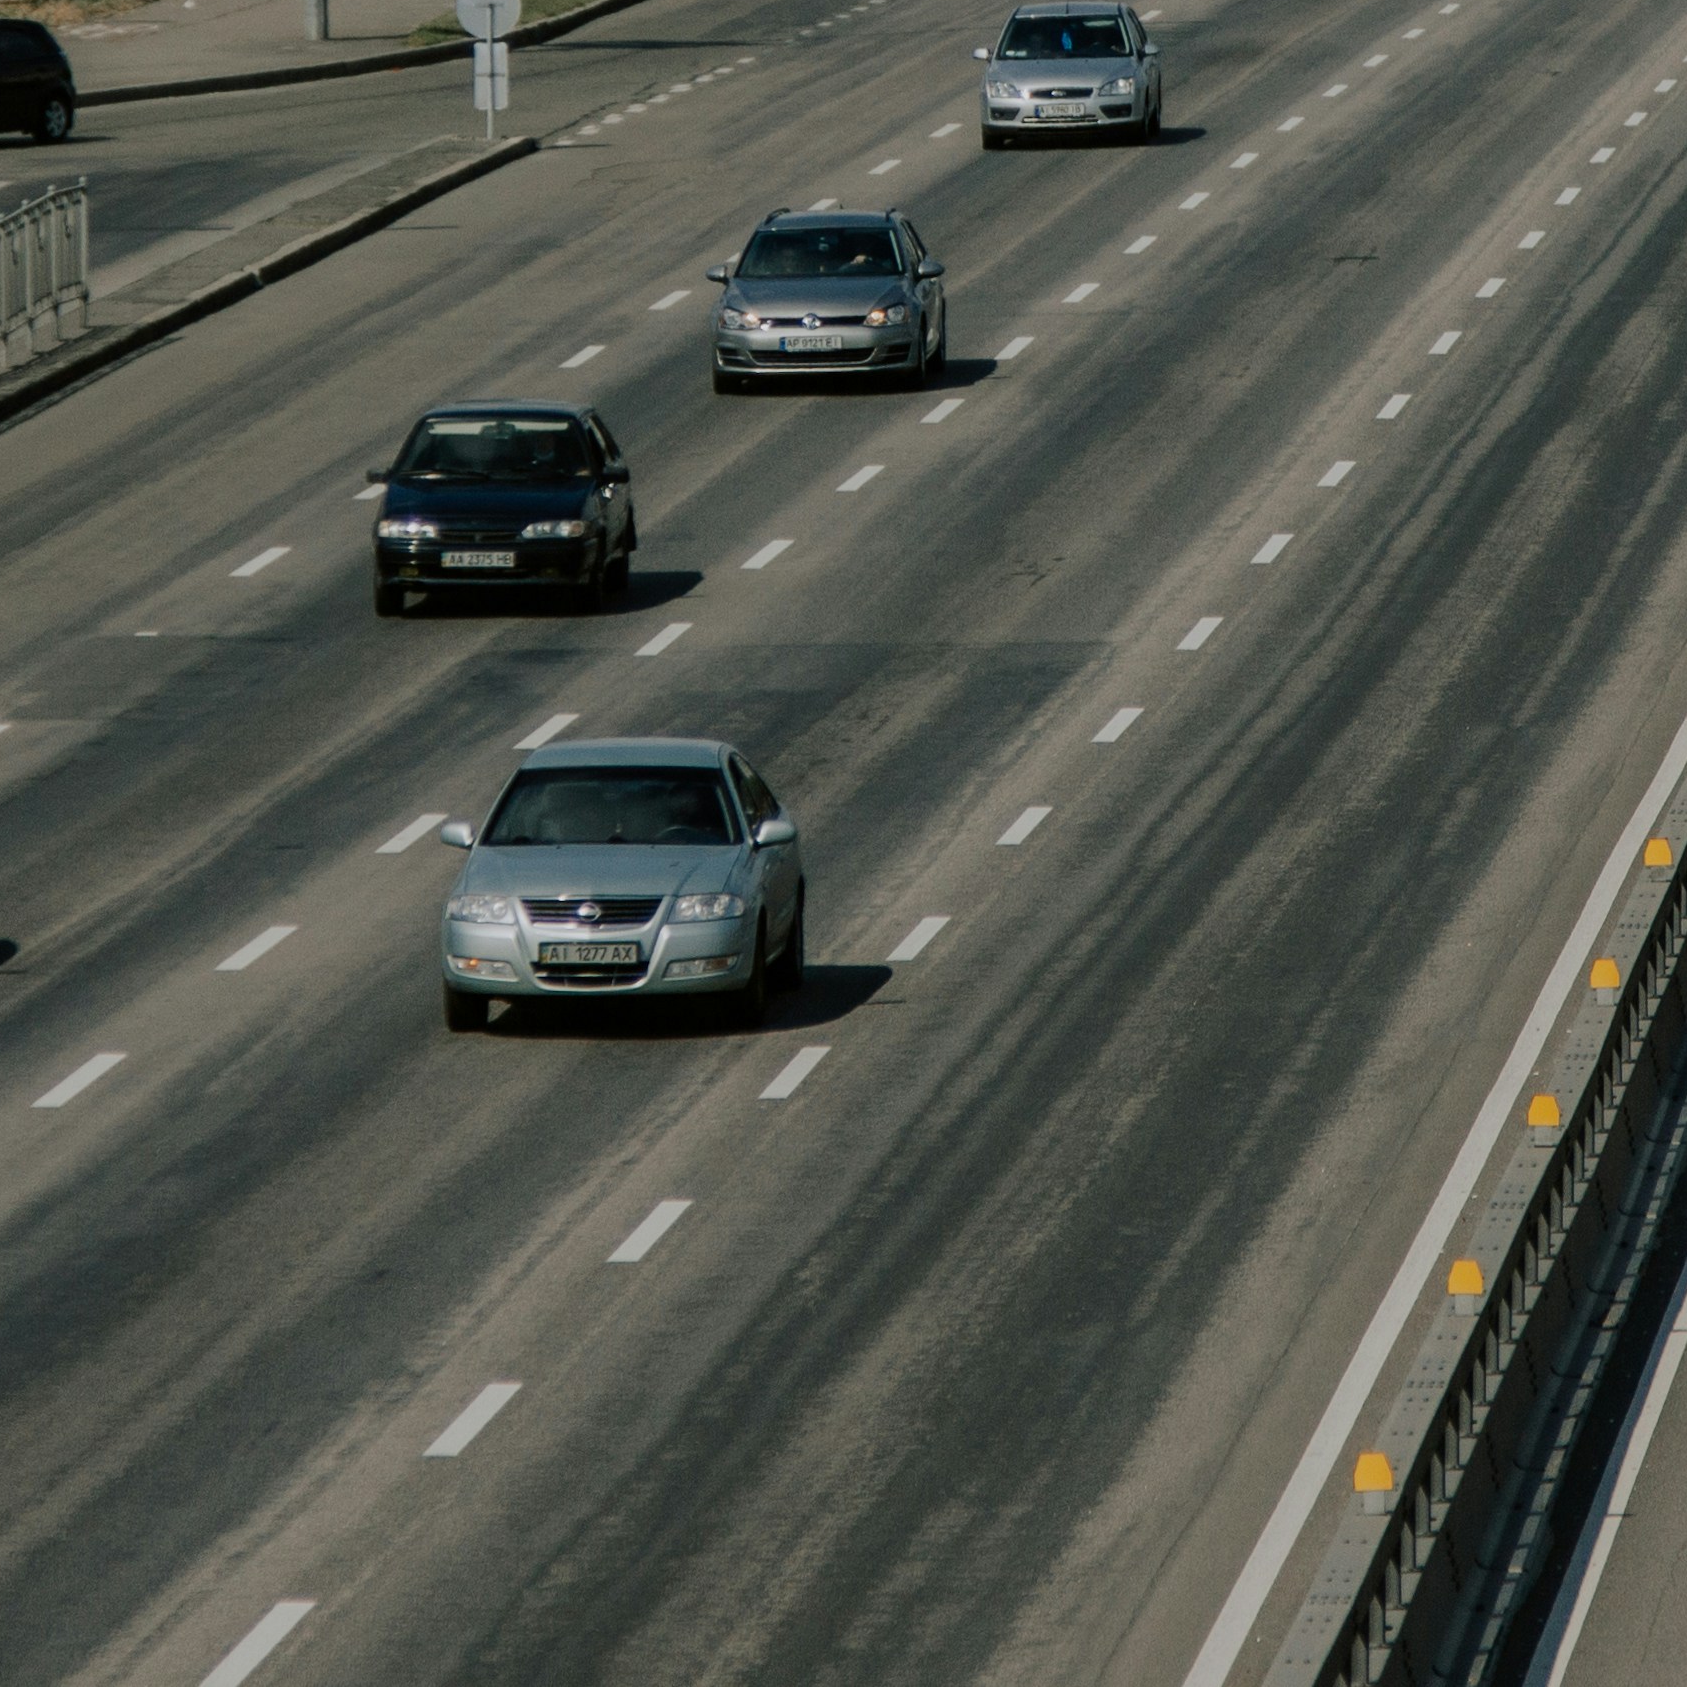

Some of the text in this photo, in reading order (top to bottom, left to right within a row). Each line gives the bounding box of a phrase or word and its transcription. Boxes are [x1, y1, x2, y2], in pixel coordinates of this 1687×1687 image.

[549, 947, 633, 961] AI 1277 AX
